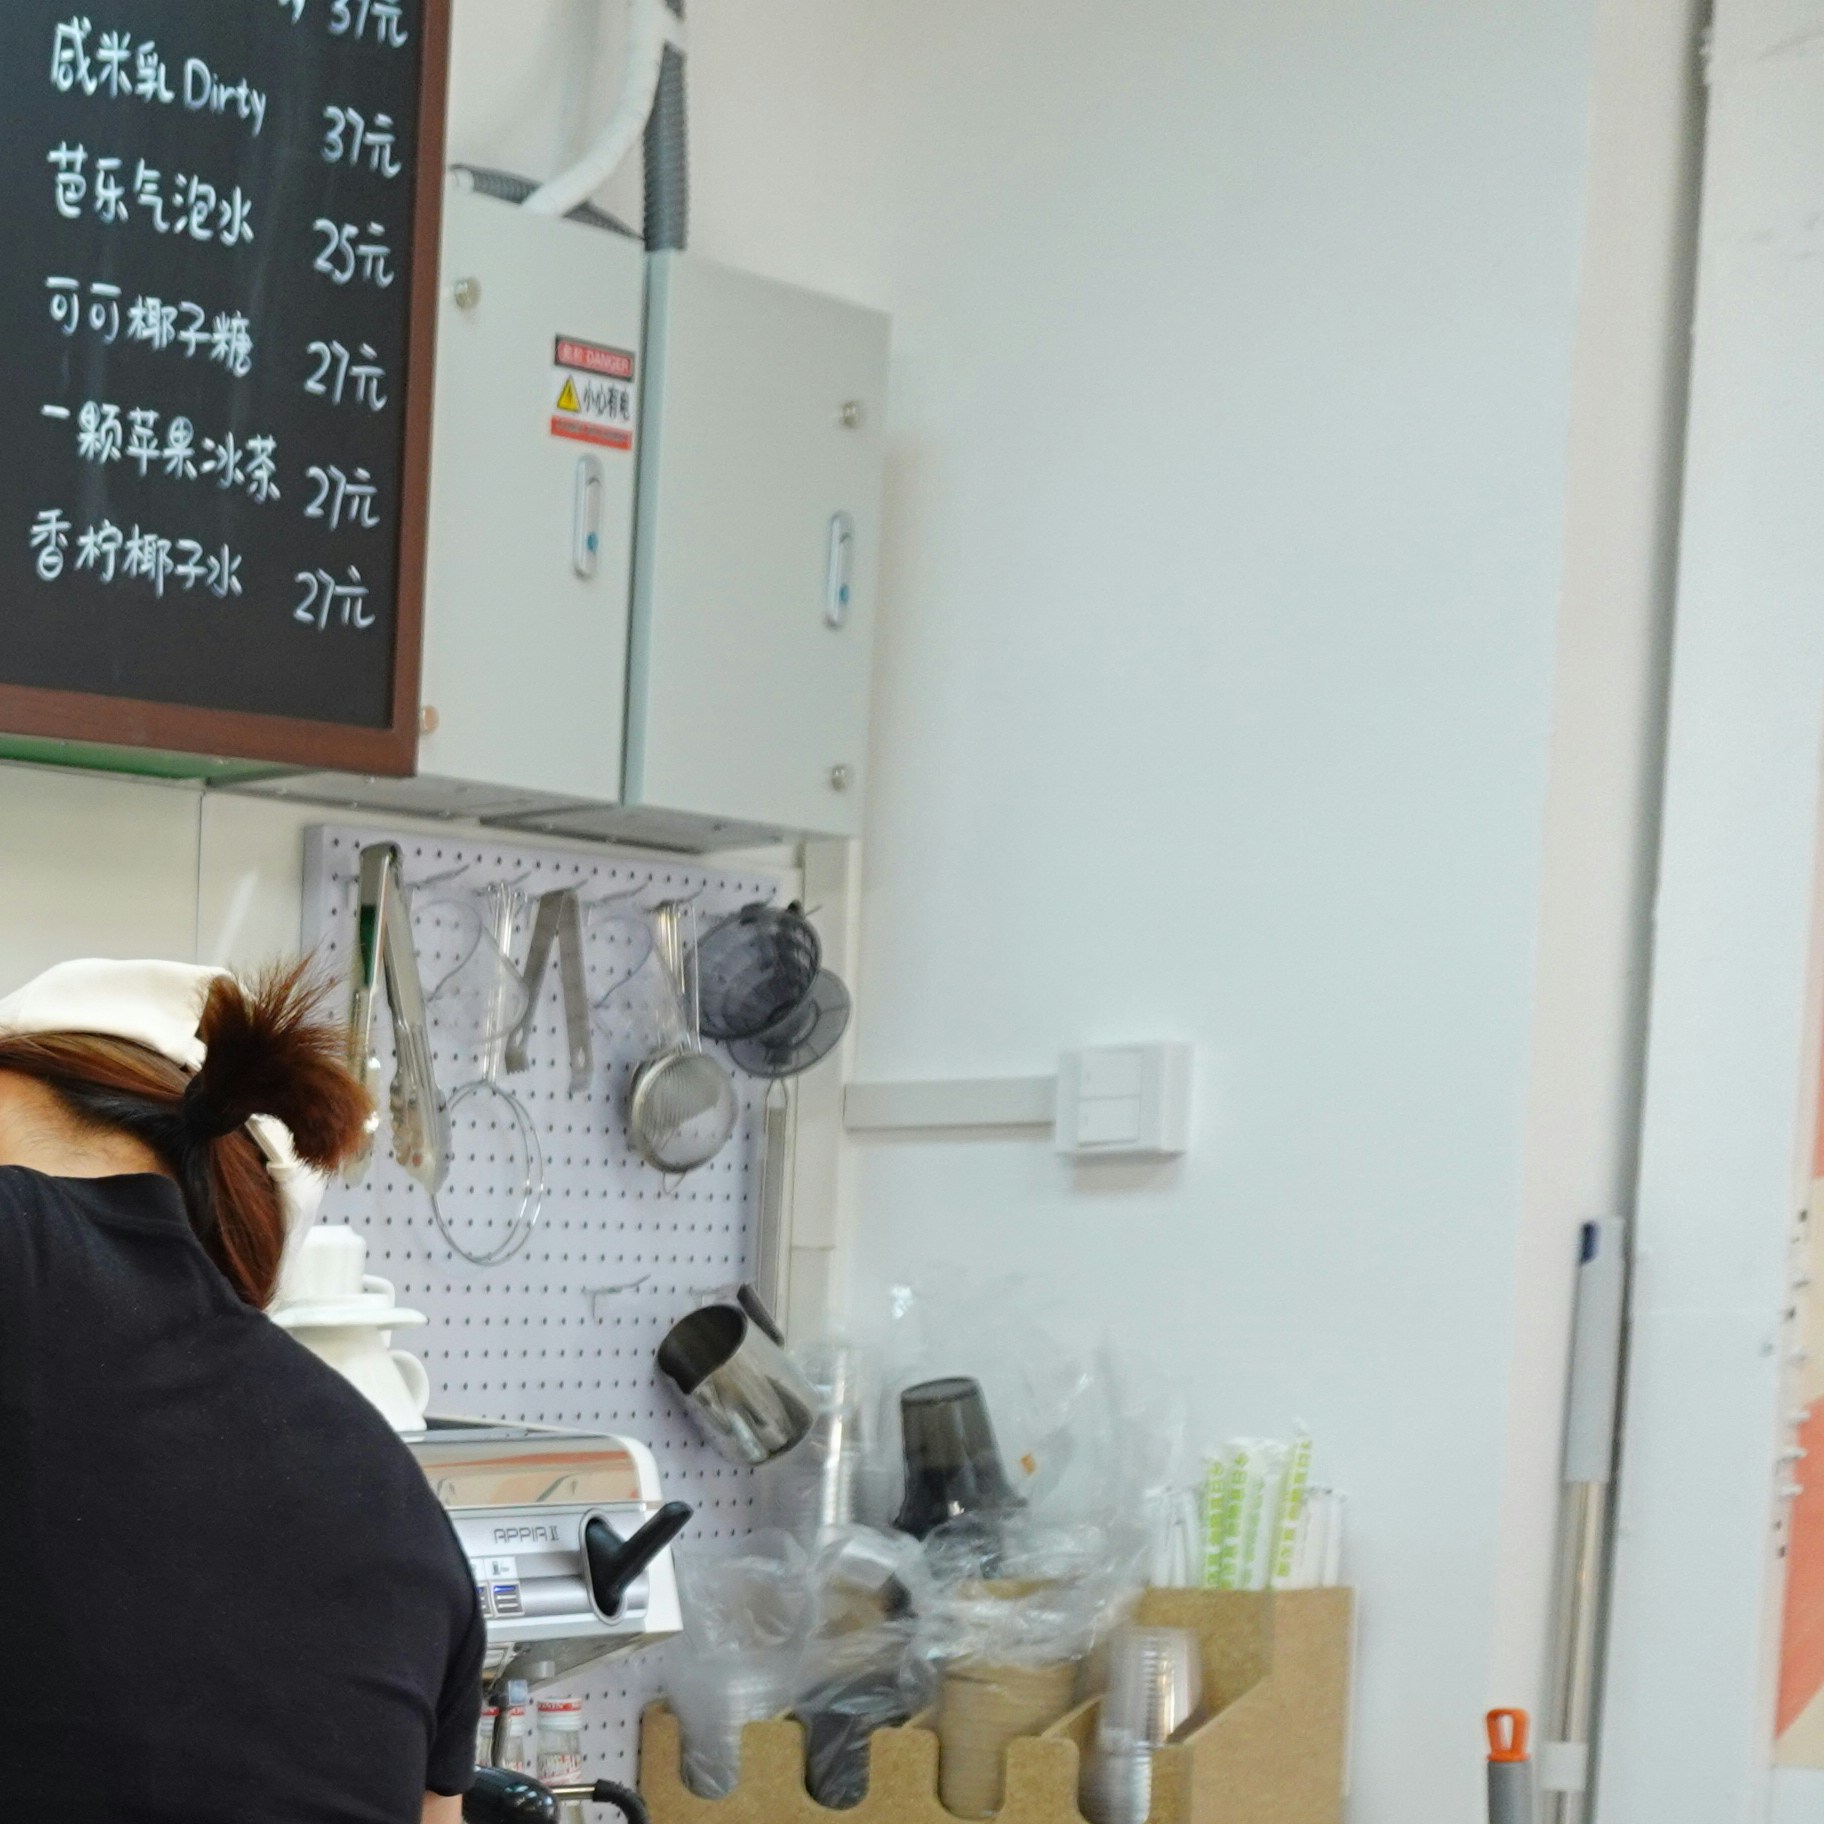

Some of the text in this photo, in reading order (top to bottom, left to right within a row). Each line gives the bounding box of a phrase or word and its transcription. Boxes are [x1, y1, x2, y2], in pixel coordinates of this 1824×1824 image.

[183, 57, 266, 136] Dirty
[321, 105, 401, 178] 37元
[47, 140, 394, 288] 芭乐气泡水 25元
[45, 276, 387, 411] 可可椰子糖 27元
[40, 400, 380, 531] 一颗苹果冰茶 27元
[30, 508, 376, 632] 香柠椰子水 27元
